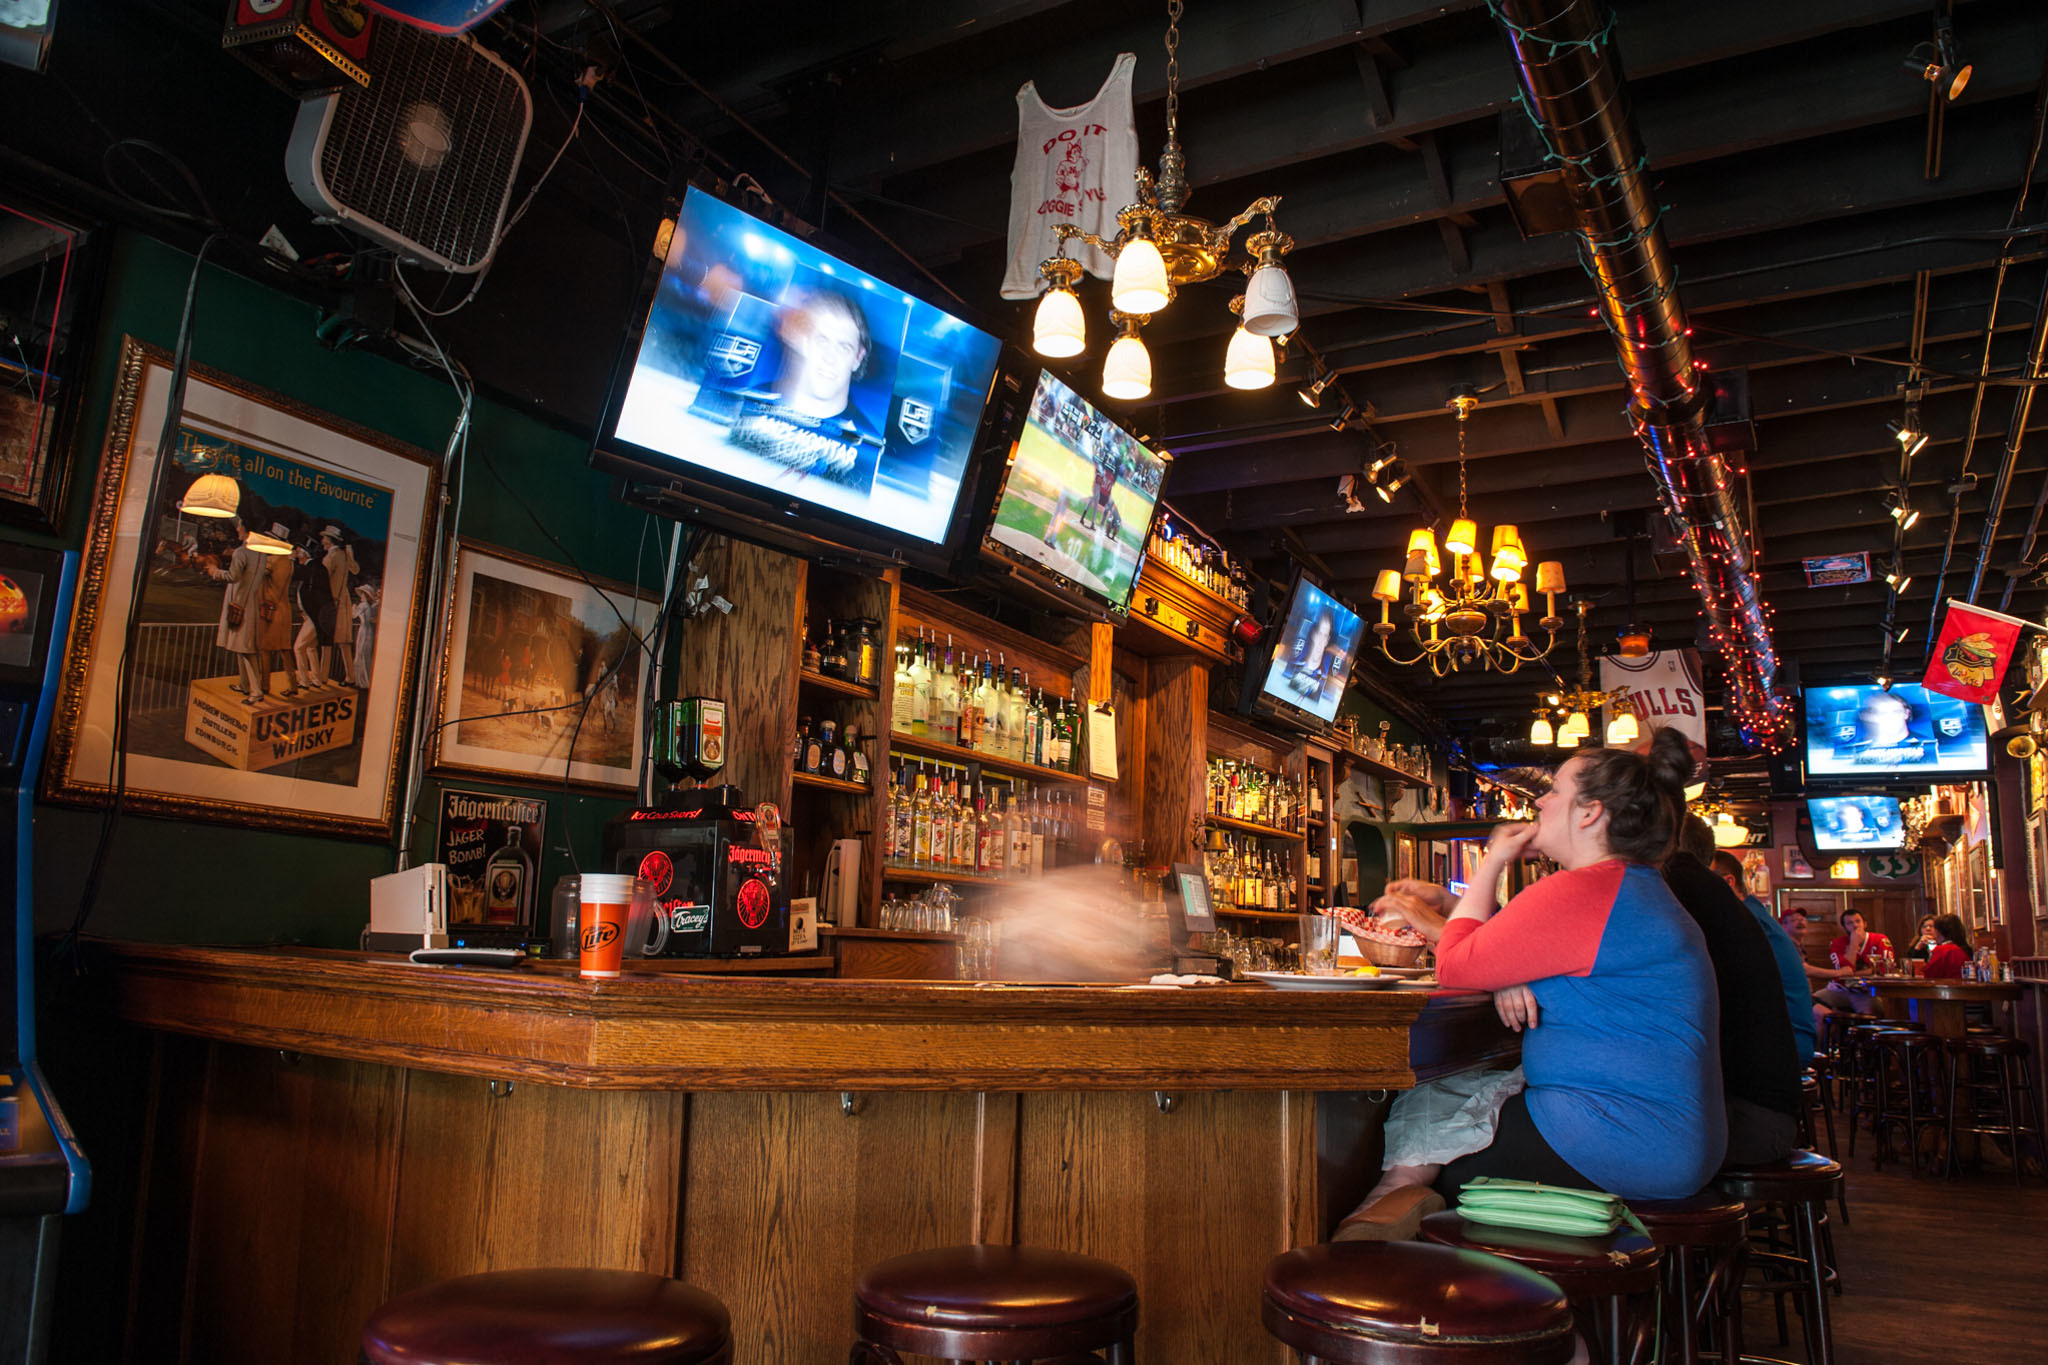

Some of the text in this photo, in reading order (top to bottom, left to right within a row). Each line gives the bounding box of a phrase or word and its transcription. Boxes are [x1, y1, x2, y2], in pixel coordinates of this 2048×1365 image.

[1043, 124, 1108, 155] DO IT
[1037, 199, 1075, 217] DGGIE
[245, 456, 264, 475] all
[266, 465, 284, 481] on
[288, 468, 312, 490] the
[256, 697, 353, 741] USHER'S
[1612, 687, 1698, 722] ULLS
[202, 716, 237, 740] DISTILLERS
[273, 728, 335, 760] WHISKY
[631, 811, 647, 820] ICE
[647, 811, 669, 820] COLD
[675, 910, 708, 929] Tracey's
